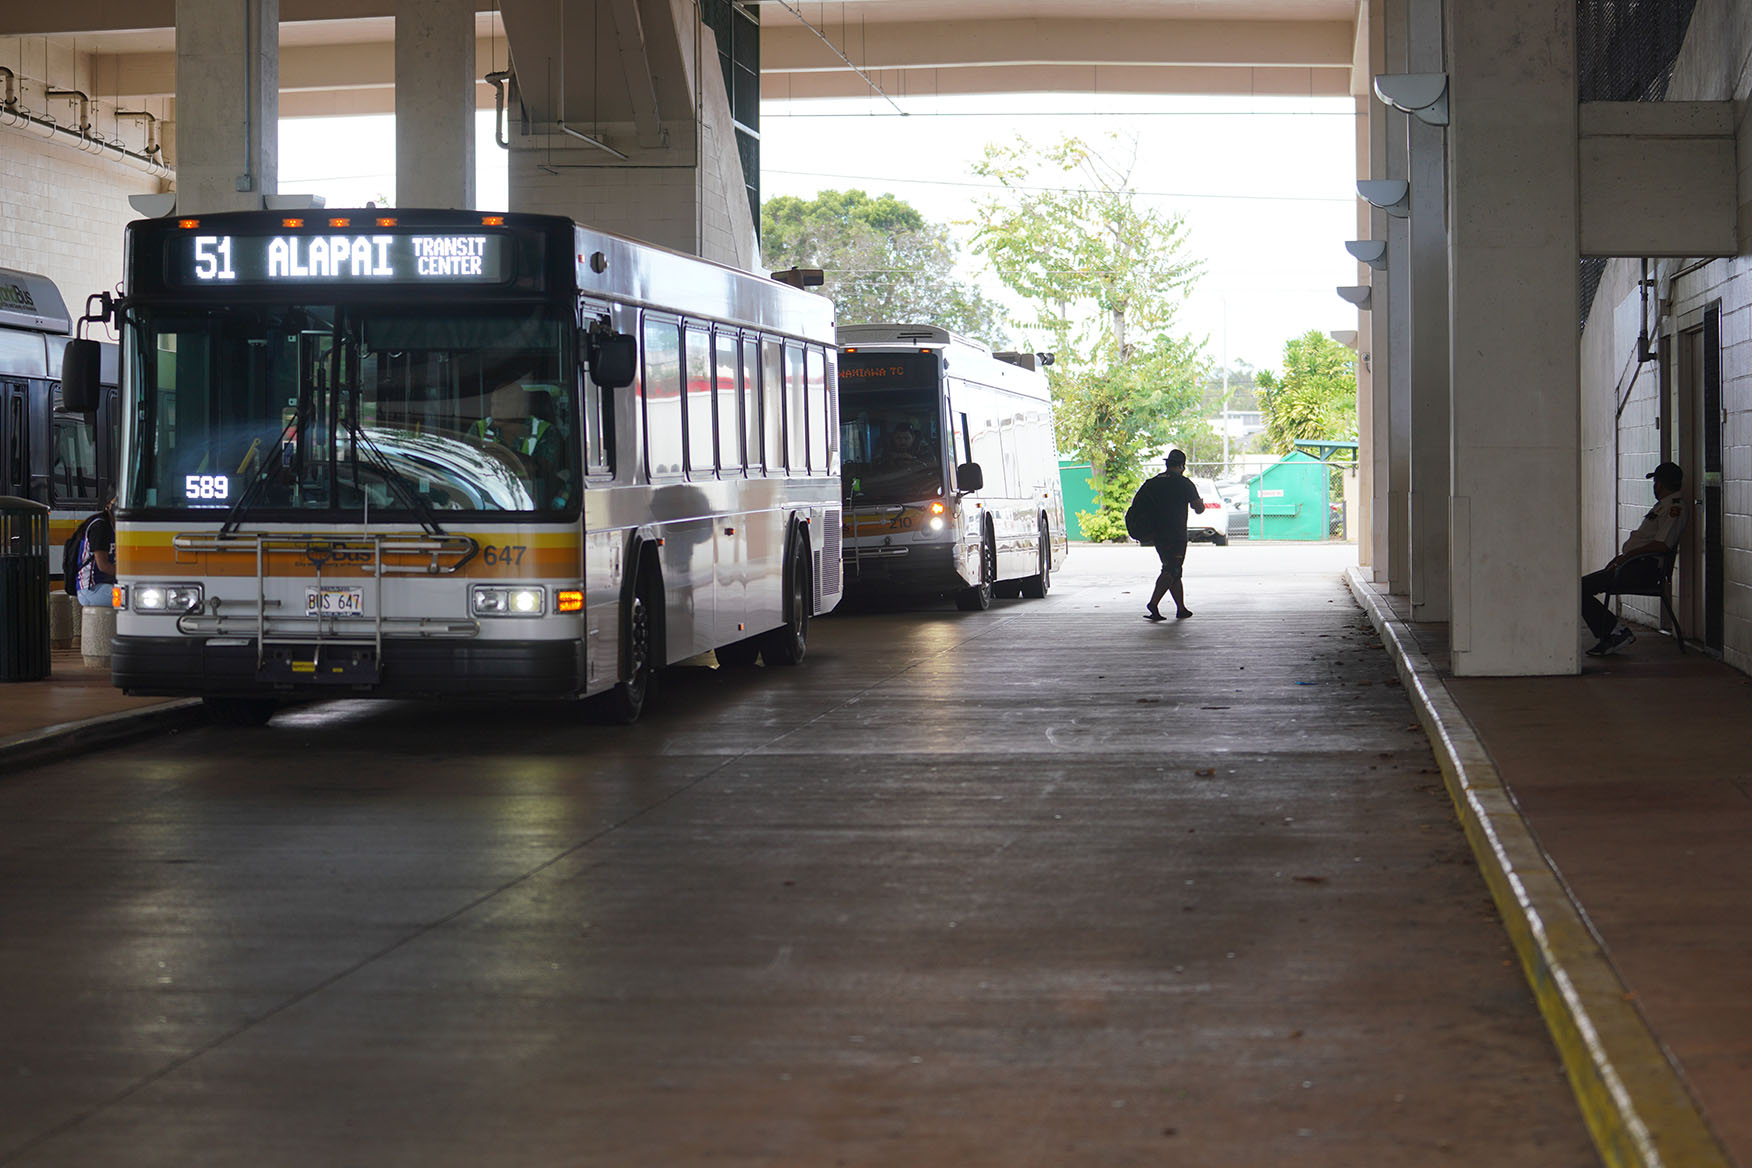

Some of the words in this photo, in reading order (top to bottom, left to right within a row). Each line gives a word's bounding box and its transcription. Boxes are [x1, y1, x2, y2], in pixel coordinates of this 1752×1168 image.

[412, 237, 486, 256] TRANSIT
[195, 236, 236, 279] 51
[268, 236, 394, 277] ALAPAI
[417, 256, 483, 276] CENTER
[889, 365, 905, 376] TC
[185, 475, 229, 499] 589
[889, 517, 912, 529] 210
[484, 545, 527, 566] 647
[308, 593, 331, 610] BUS
[338, 593, 360, 610] 647
